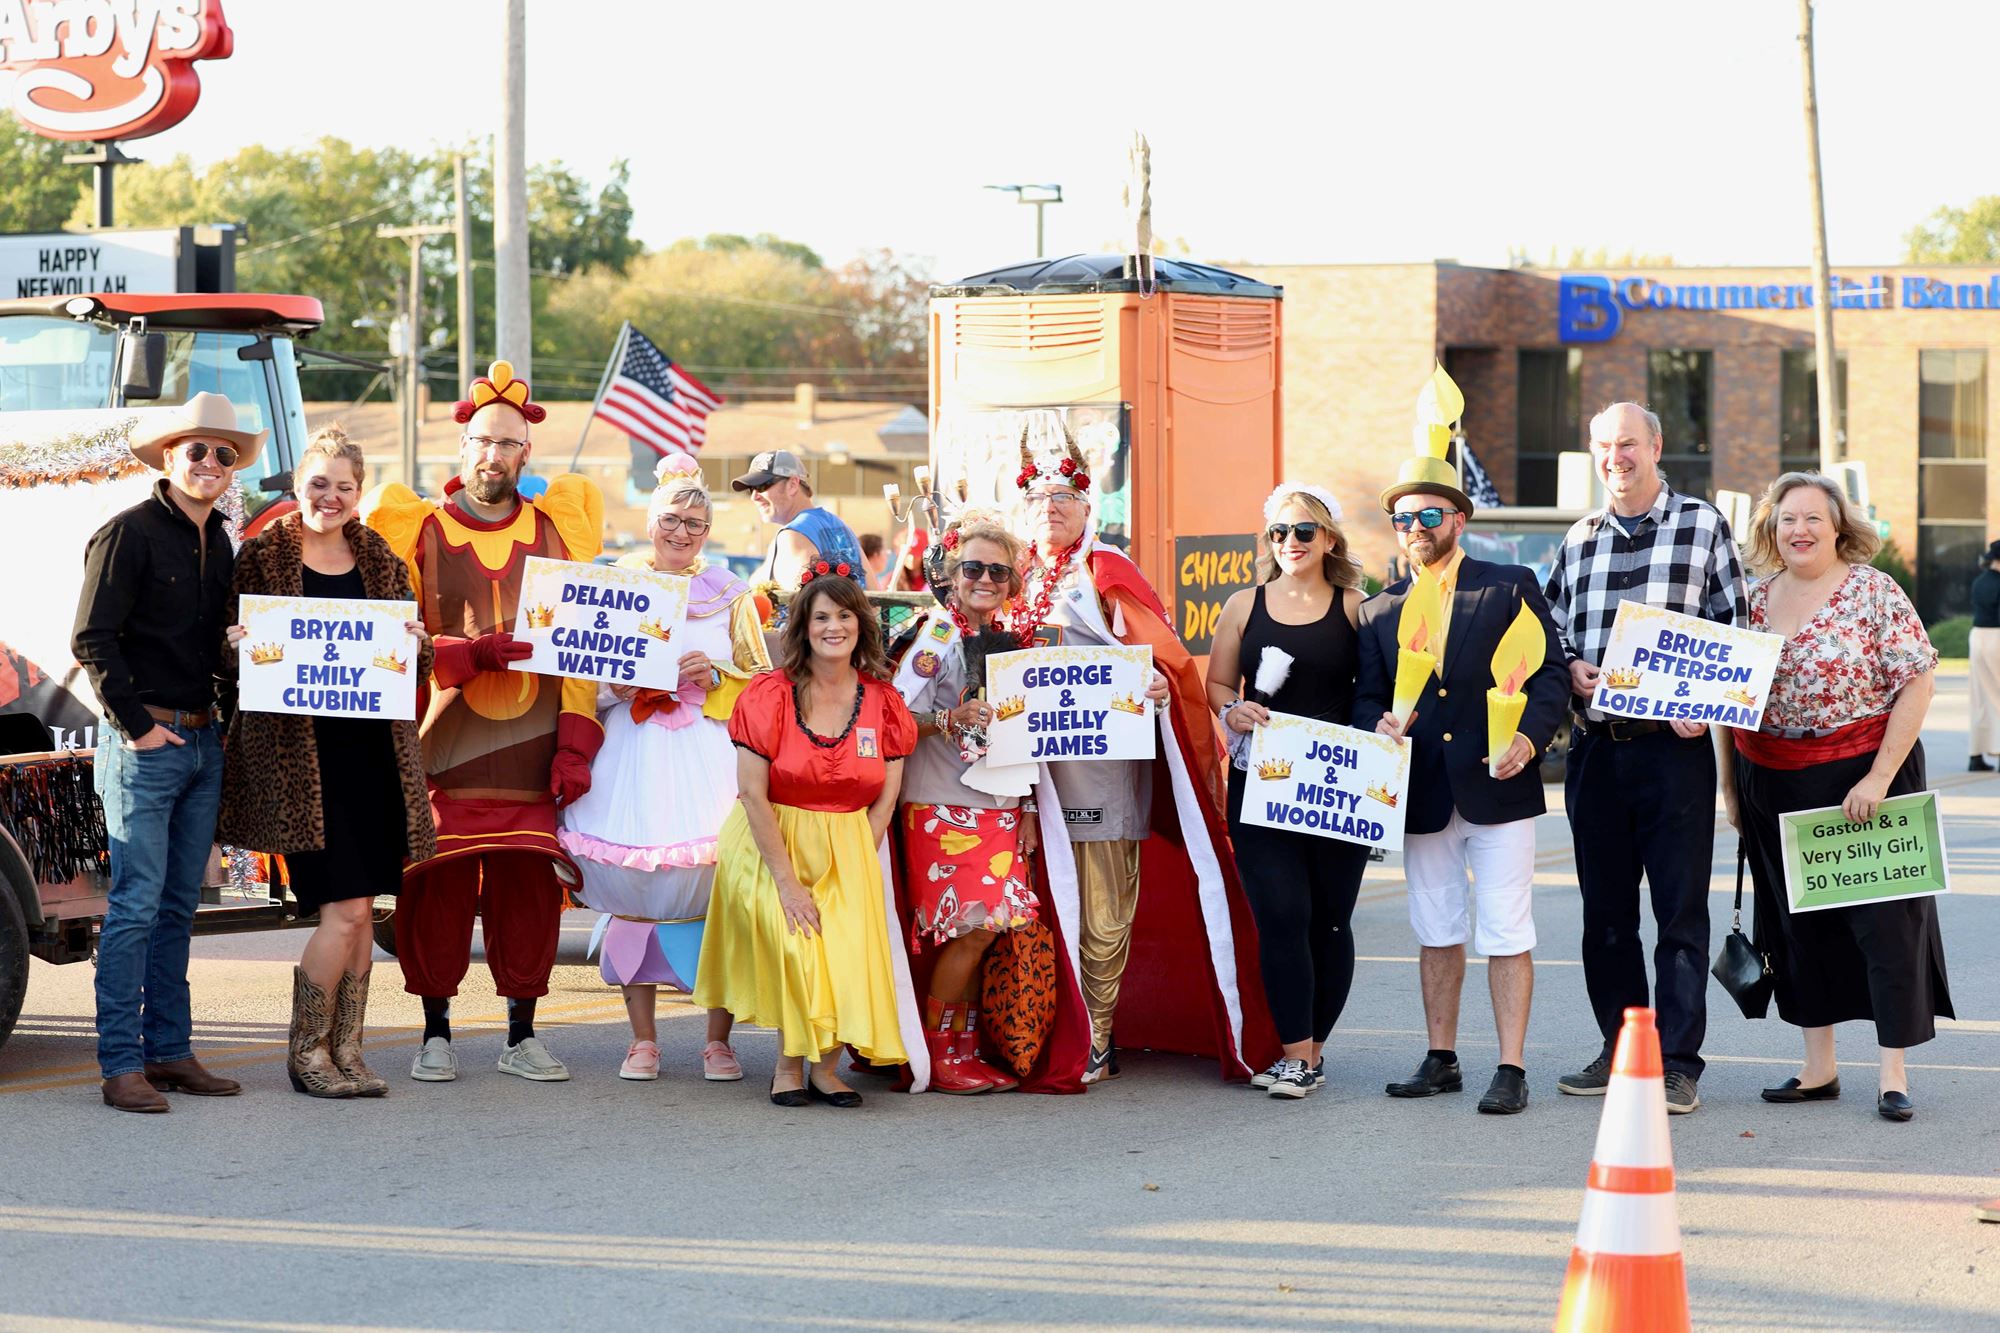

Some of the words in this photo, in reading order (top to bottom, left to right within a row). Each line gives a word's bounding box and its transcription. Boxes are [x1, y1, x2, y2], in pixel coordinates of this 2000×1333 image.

[39, 247, 101, 273] HAPPY
[1180, 550, 1254, 593] CHICKS
[561, 583, 650, 613] DELANO
[290, 618, 374, 641] BRYAN
[593, 611, 610, 630] &
[323, 643, 340, 662] &
[551, 627, 649, 658] CANDICE
[1656, 629, 1733, 663] BRUCE
[296, 664, 366, 687] EMILY
[557, 651, 636, 681] WATTS
[1022, 665, 1113, 689] GEORGE
[1632, 647, 1752, 683] PETERSON
[282, 687, 382, 712] CLUBINE
[1059, 689, 1076, 708] &
[1674, 681, 1690, 697] &
[1597, 688, 1650, 716] LOIS
[1652, 699, 1760, 727] LESSMAN
[1027, 710, 1109, 733] SHELLY
[1031, 734, 1108, 758] JAMES
[1305, 740, 1358, 770] JOSH
[1324, 766, 1338, 784] &
[1296, 782, 1362, 814] MISTY
[1266, 801, 1384, 841] WOOLLARD
[1812, 820, 1873, 839] Gaston
[1879, 814, 1893, 829] &
[1898, 815, 1908, 827] a
[1802, 849, 1842, 865] Very
[1847, 841, 1882, 860] Silly
[1887, 835, 1924, 854] Girl,
[1806, 874, 1827, 891] 50
[1831, 870, 1878, 887] Years
[1883, 863, 1927, 881] Later
